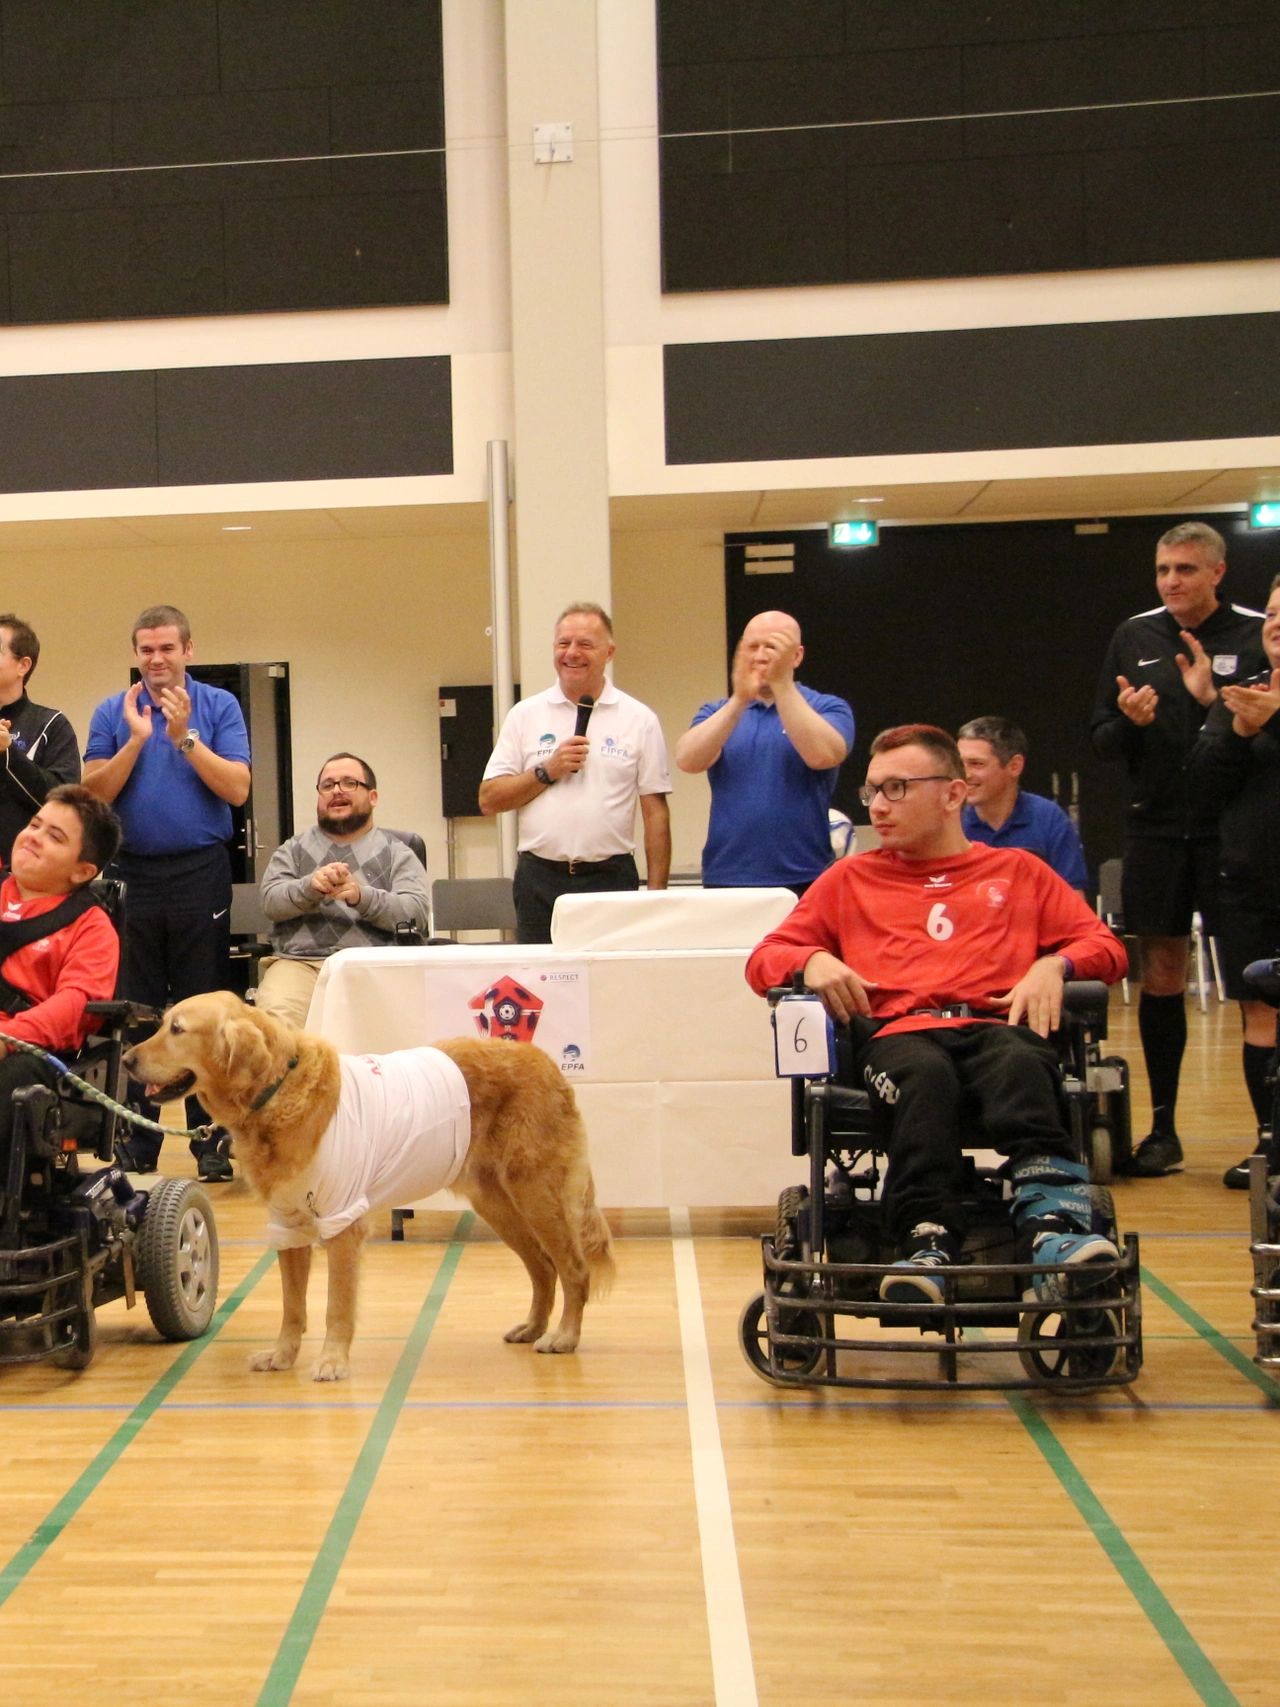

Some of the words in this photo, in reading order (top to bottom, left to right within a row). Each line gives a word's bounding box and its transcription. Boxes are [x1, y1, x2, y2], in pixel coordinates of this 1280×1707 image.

[926, 902, 954, 941] 6
[794, 1016, 808, 1053] 6
[561, 1063, 585, 1071] EPFA
